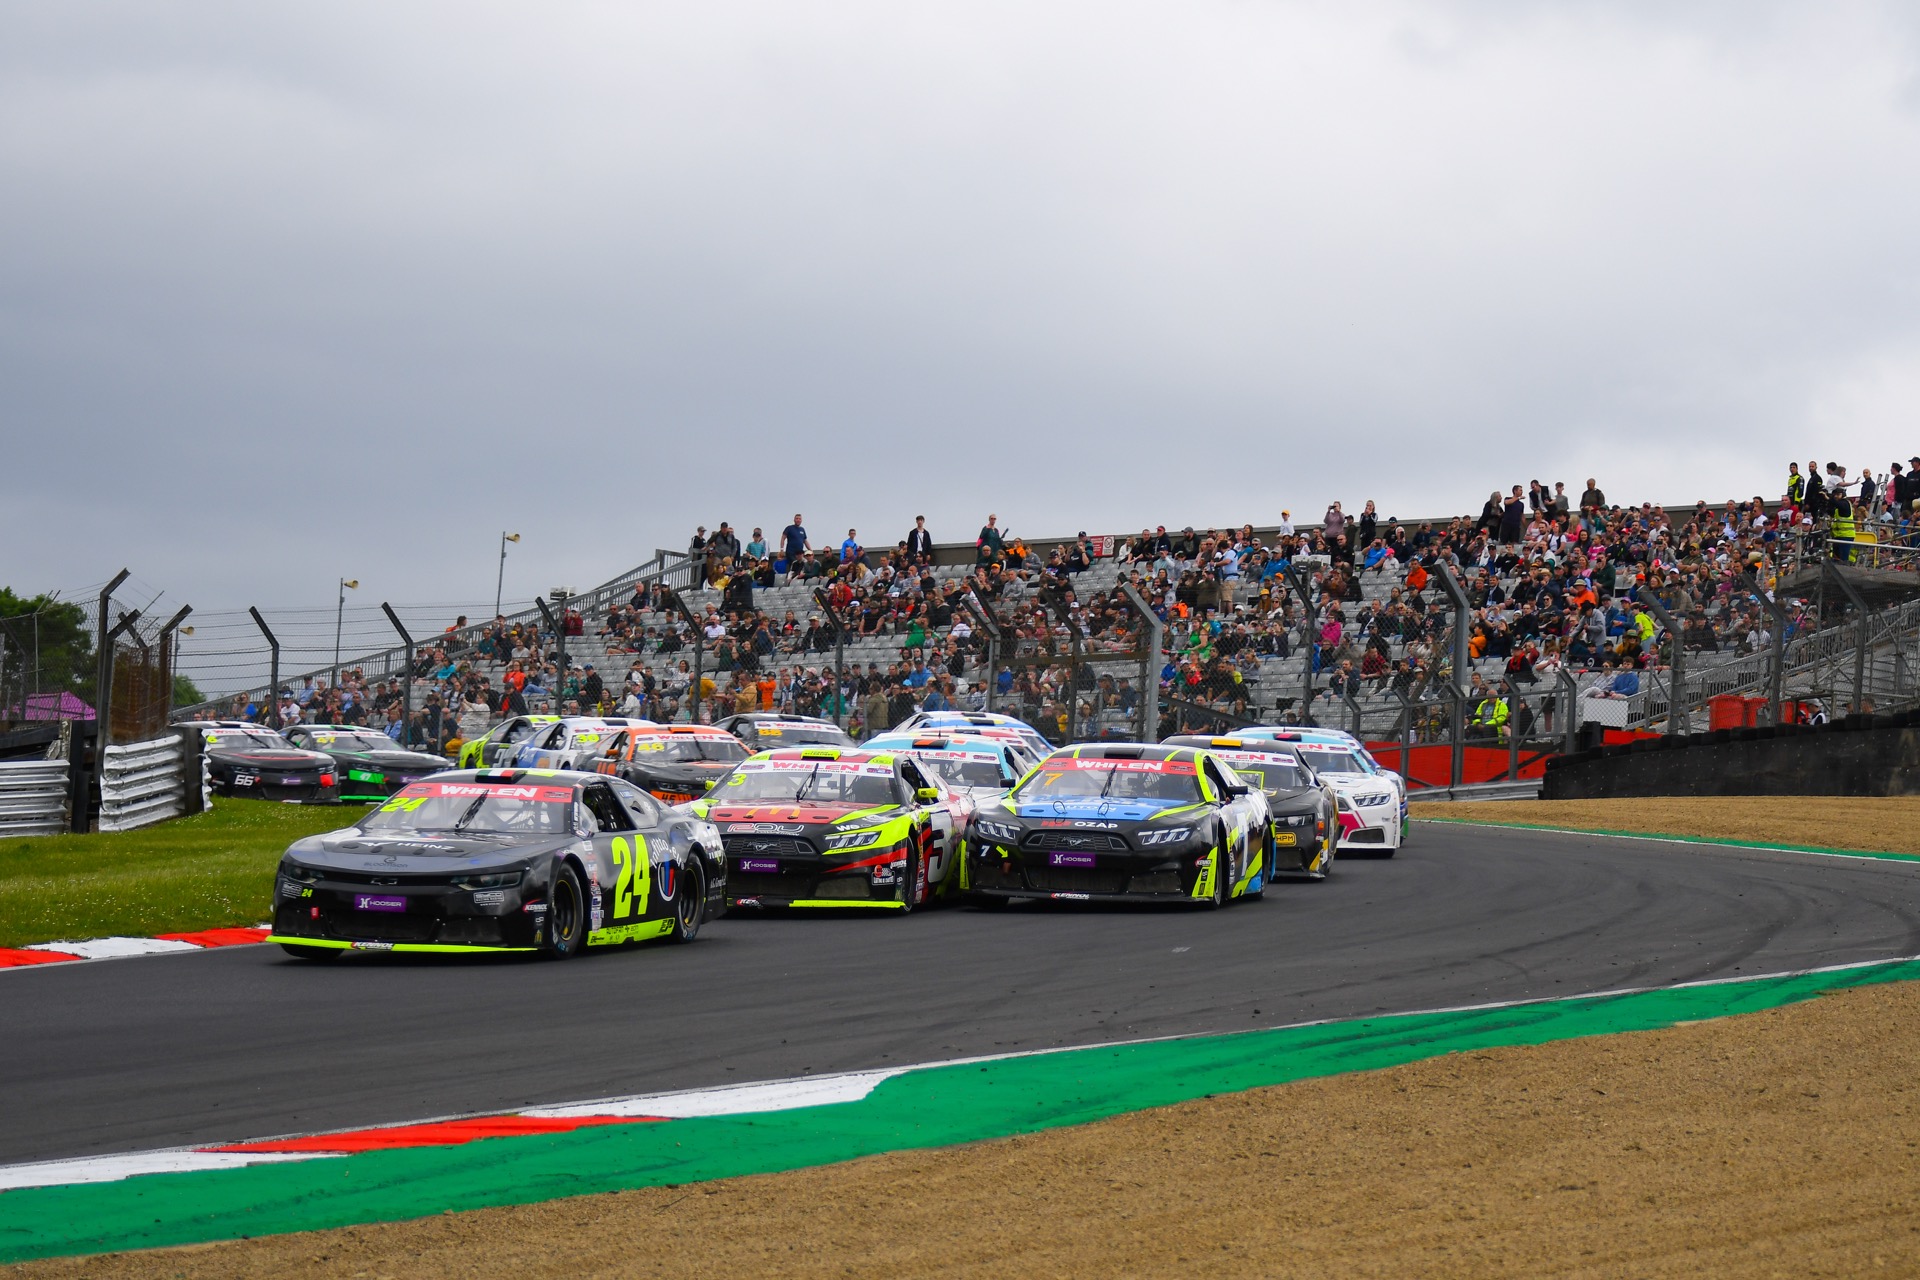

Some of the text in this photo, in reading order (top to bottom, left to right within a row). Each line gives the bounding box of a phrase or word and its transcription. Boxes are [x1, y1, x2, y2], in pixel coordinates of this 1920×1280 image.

[772, 761, 860, 772] WHELEN
[1075, 759, 1163, 771] WHELEN
[234, 774, 254, 786] 66
[727, 773, 747, 787] 3
[1044, 773, 1064, 786] 7
[440, 784, 538, 798] WHELEN
[379, 797, 428, 812] 24
[1074, 821, 1119, 829] OZAP
[397, 841, 456, 850] HEINZ
[980, 844, 991, 857] 7
[611, 833, 651, 919] 24
[301, 888, 314, 898] 24
